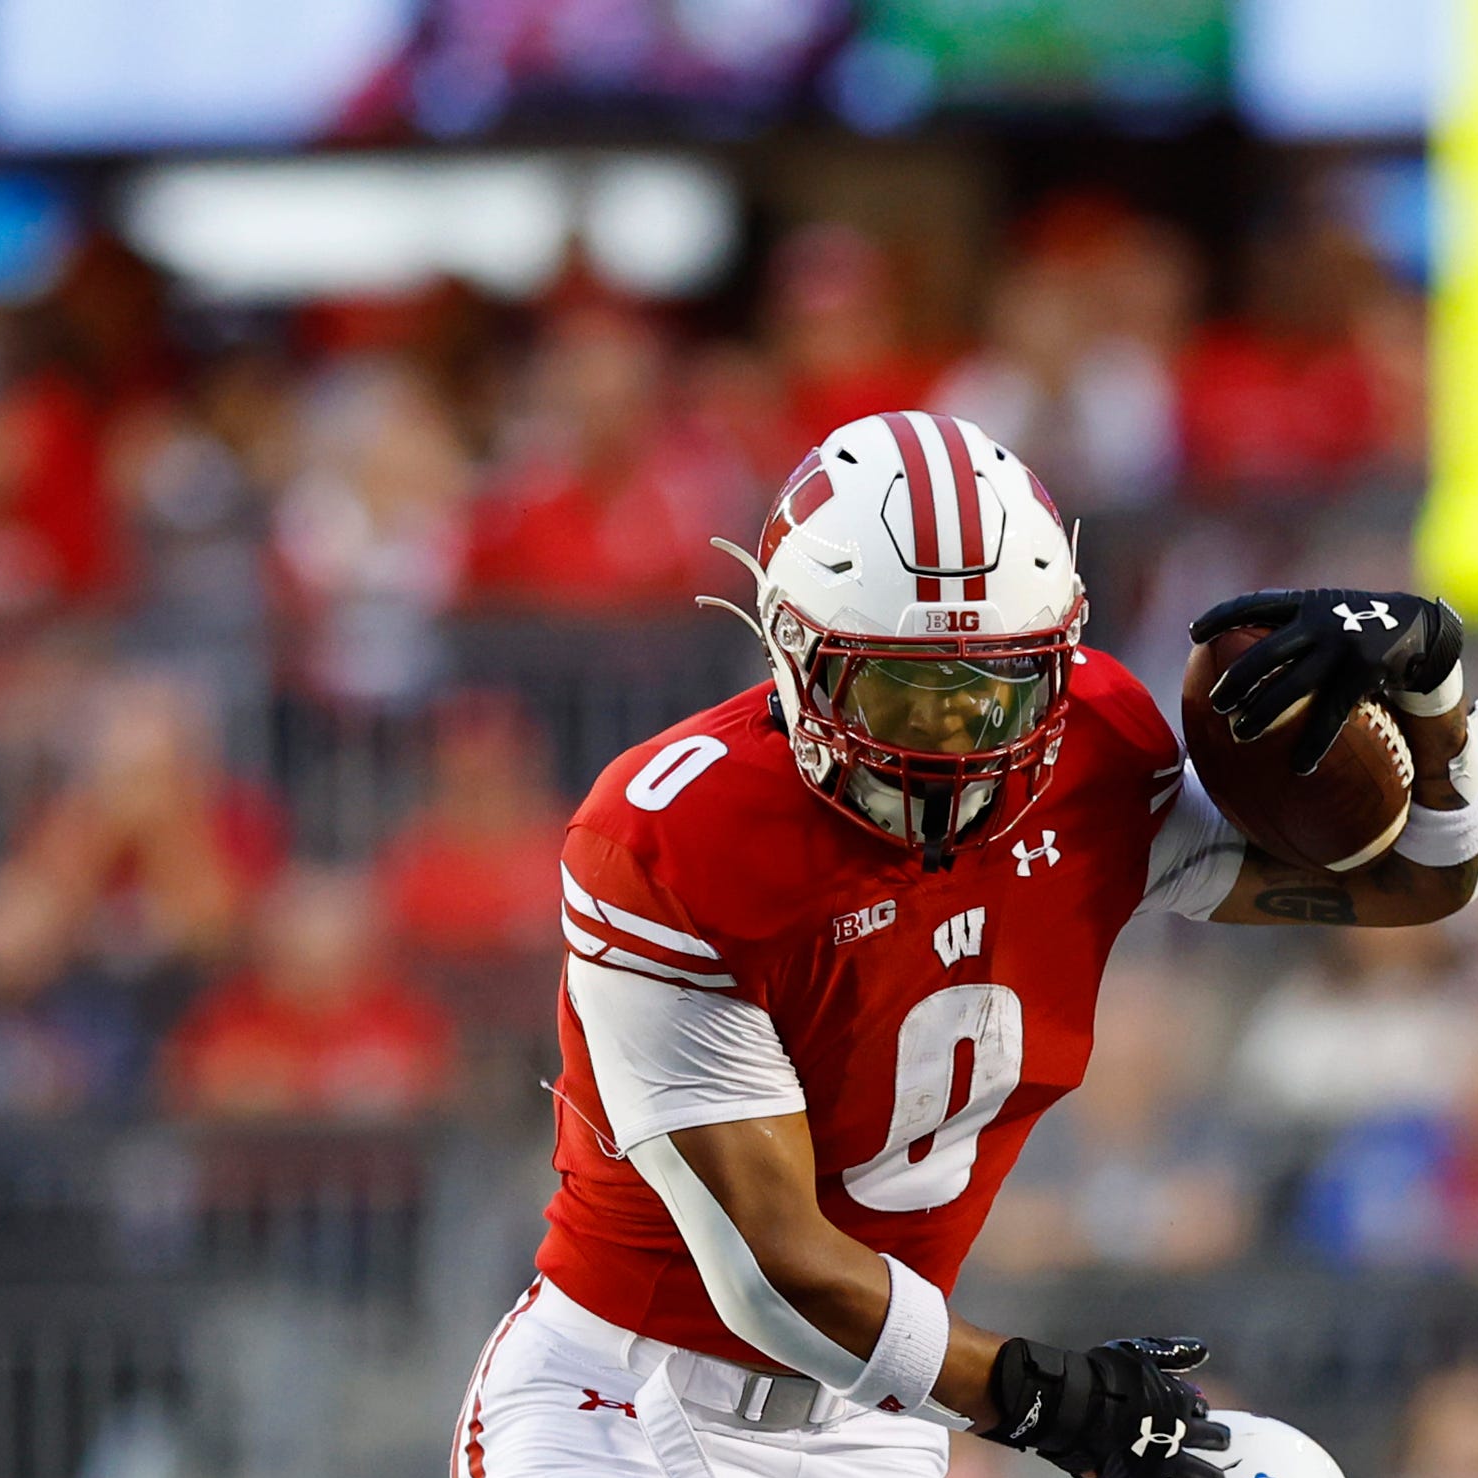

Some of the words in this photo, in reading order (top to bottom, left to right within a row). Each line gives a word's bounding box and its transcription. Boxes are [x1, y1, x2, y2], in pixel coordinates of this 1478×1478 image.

[626, 735, 729, 811] 0
[933, 906, 985, 969] W
[842, 984, 1023, 1213] 0
